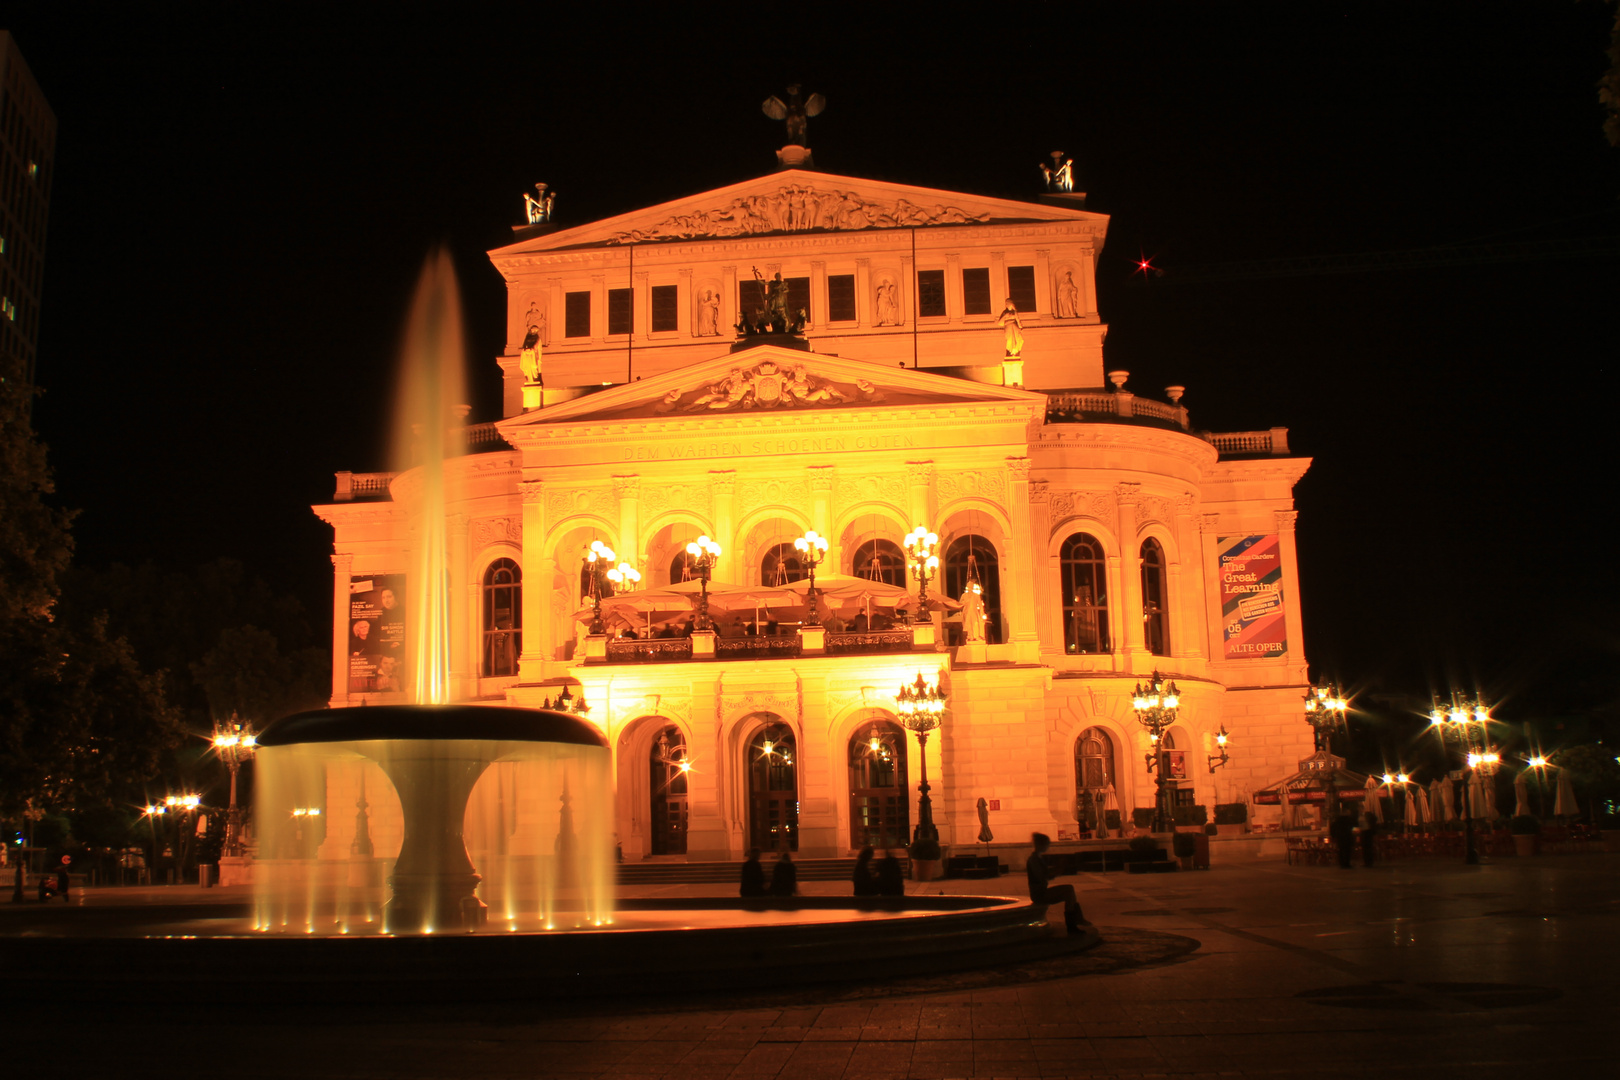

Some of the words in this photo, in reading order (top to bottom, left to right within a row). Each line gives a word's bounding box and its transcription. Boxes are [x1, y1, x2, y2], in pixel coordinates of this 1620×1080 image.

[624, 446, 659, 460] DEM
[667, 442, 742, 458] WAHREN
[752, 437, 845, 454] SCHOENEN
[1222, 562, 1246, 572] The
[1224, 572, 1257, 583] Great
[1224, 582, 1279, 594] Learning
[1229, 643, 1254, 653] ALTE
[1256, 642, 1283, 652] OPER
